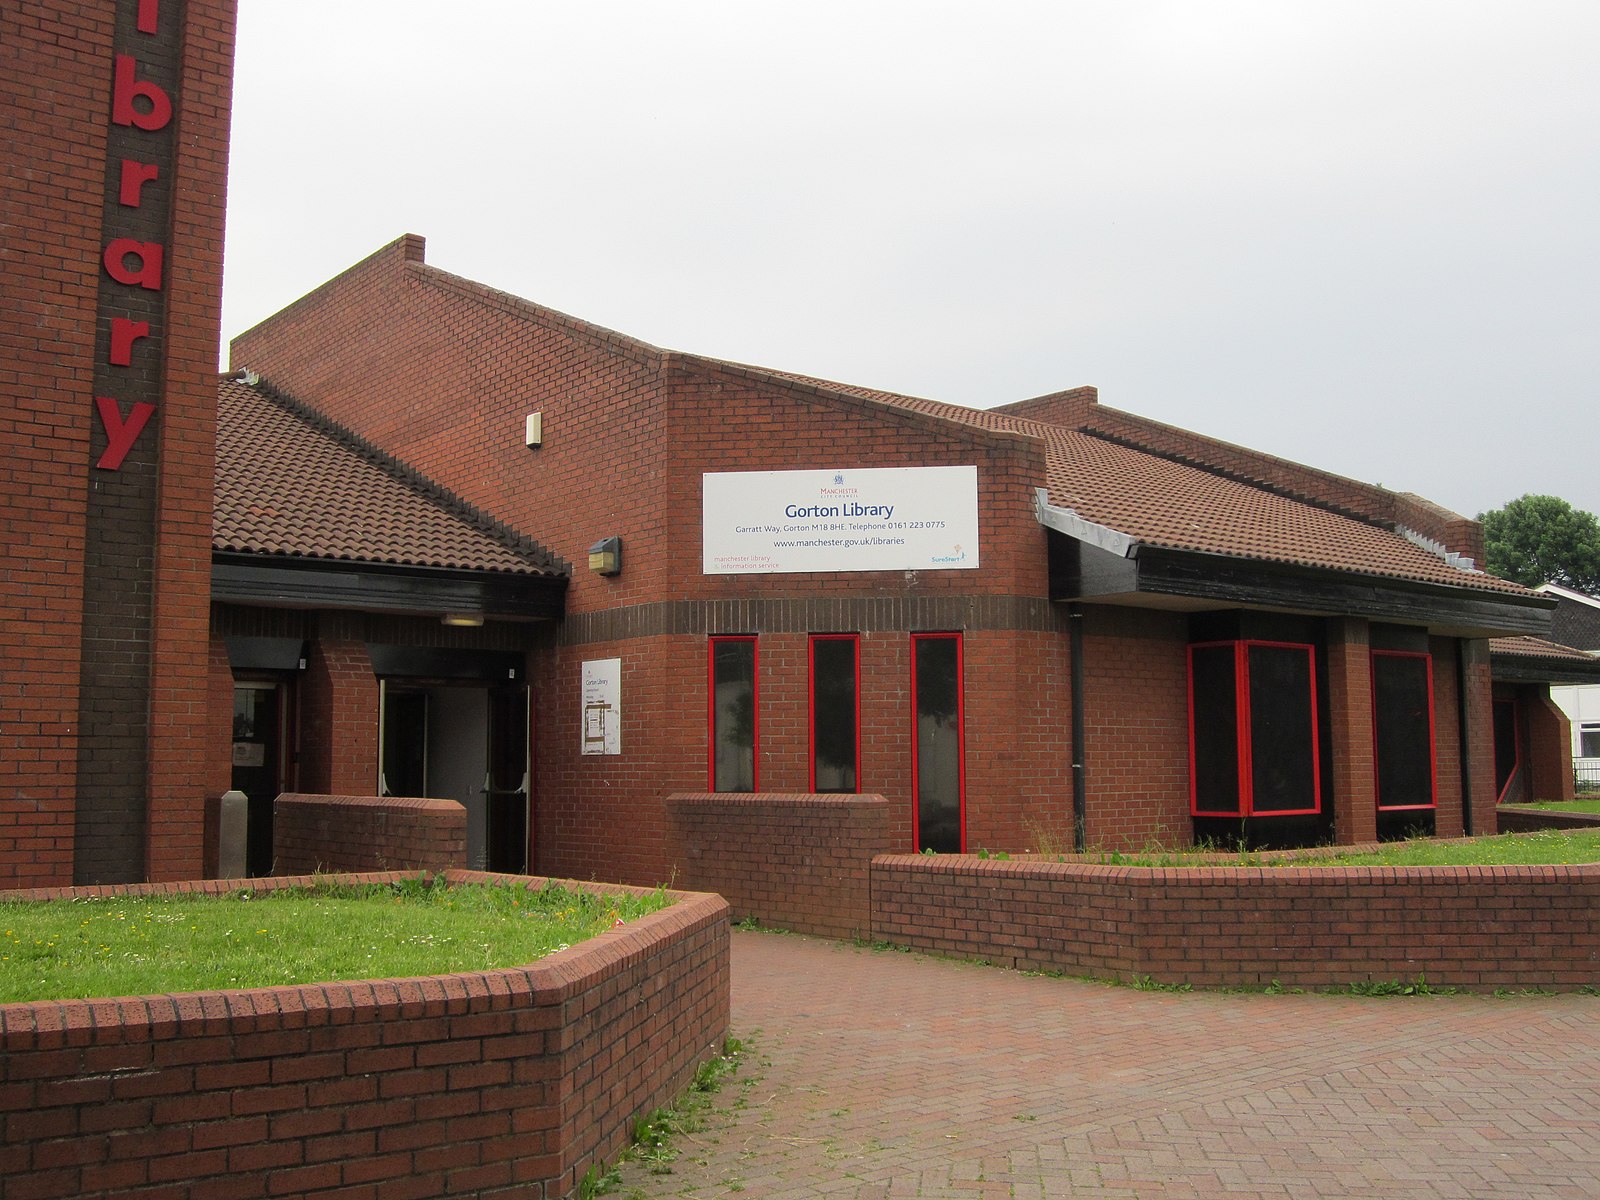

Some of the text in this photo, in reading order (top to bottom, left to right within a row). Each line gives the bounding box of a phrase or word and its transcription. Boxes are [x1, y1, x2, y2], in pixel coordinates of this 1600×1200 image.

[785, 502, 894, 520] Gorton Library
[735, 525, 762, 533] Garratt
[764, 525, 782, 534] Way,
[783, 524, 810, 532] Gorton
[830, 523, 847, 531] 8HE.
[849, 522, 886, 532] Telephone
[888, 521, 907, 530] 0161
[910, 521, 924, 529] 223
[926, 521, 946, 529] 0775
[773, 537, 905, 548] www.manchester.gov.uk/libraries
[750, 555, 771, 563] library
